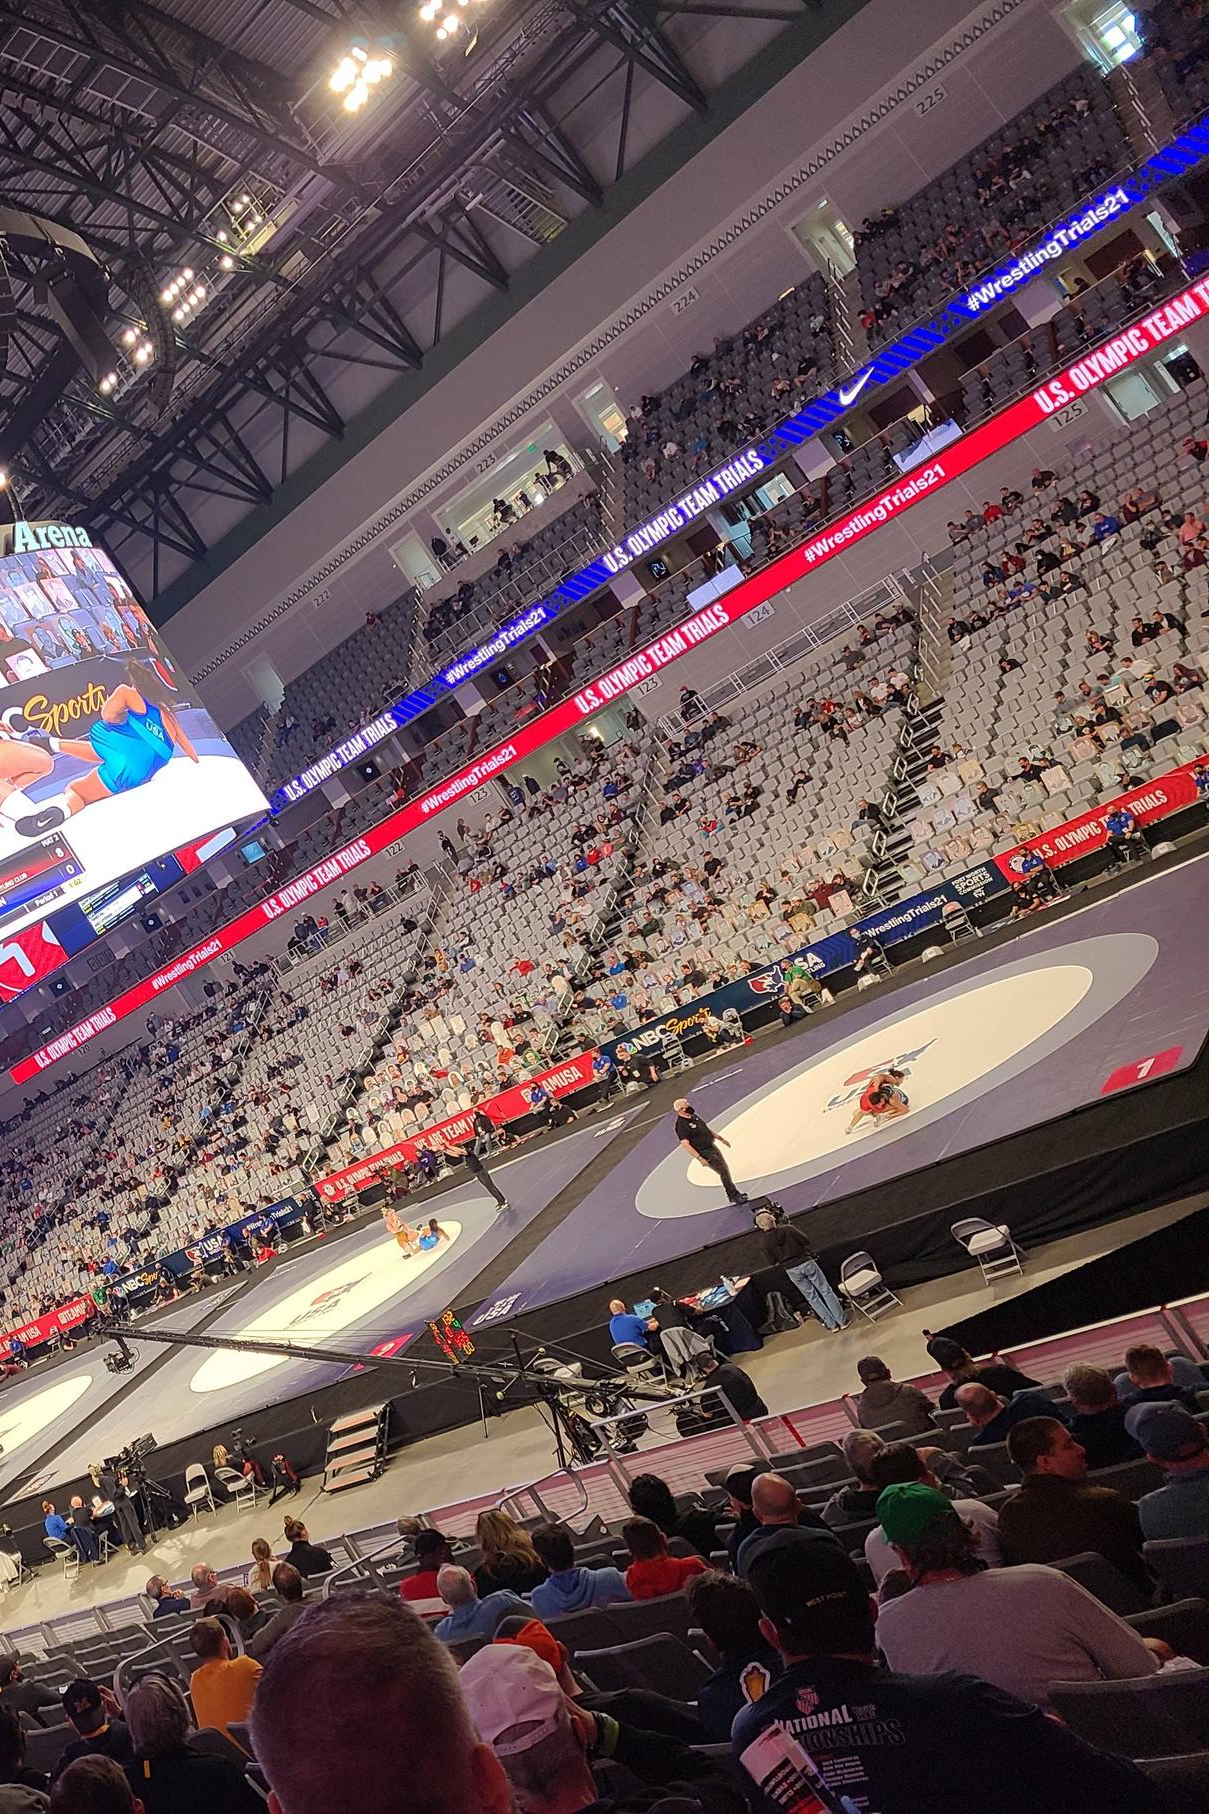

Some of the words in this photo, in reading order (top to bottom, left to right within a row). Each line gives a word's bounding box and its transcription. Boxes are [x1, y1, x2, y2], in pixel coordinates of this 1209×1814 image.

[916, 88, 946, 115] 225
[966, 189, 1131, 312] #WrestlingTrials21
[673, 291, 697, 313] 224
[1034, 380, 1076, 414] U.S.
[1069, 328, 1149, 391] OLYMPIC
[1141, 294, 1202, 341] TEAM
[1052, 403, 1083, 427] 125
[476, 454, 496, 473] 223
[603, 547, 634, 573] U.S.
[627, 508, 684, 555] OLYMPIC
[677, 482, 720, 519] TEAM
[713, 449, 764, 494] TRIALS
[803, 464, 946, 563] #WrestlingTrials21
[11, 522, 93, 555] Arena
[313, 590, 330, 607] 222
[746, 605, 771, 625] 124
[444, 608, 547, 684] #WrestlingTrials21
[574, 691, 604, 714] U.S.
[599, 656, 653, 698] OLYMPIC
[648, 635, 688, 667] TEAM
[681, 604, 730, 644] TRIALS
[637, 678, 659, 696] 123
[283, 779, 307, 801] U.S.
[301, 752, 342, 789] OLYMPIC
[335, 735, 368, 764] TEAM
[361, 712, 398, 747] TRIALS
[421, 746, 517, 814] #WrestlingTrials21
[470, 789, 488, 804] 123
[1127, 790, 1168, 817] TRIALS
[41, 836, 54, 848] MAT
[385, 842, 403, 857] 122
[1055, 822, 1102, 851] OLYMPIC
[14, 872, 28, 883] CLUB
[66, 864, 75, 875] 0
[262, 899, 284, 919] U.S.
[279, 874, 318, 908] OLYMPIC
[313, 860, 343, 885] TEAM
[336, 839, 372, 870] TRIALS
[954, 871, 991, 892] SPORTS
[34, 893, 54, 907] Period
[151, 938, 223, 990] #WrestlingTrials21
[33, 1051, 52, 1068] U.S.
[46, 1032, 77, 1060] OLYMPIC
[73, 1020, 95, 1044] TEAM
[89, 1006, 117, 1032] TRIALS
[633, 1025, 668, 1051] NBC
[1136, 1057, 1156, 1079] 1
[520, 1066, 584, 1104] @AMUSA
[442, 1117, 471, 1138] TEAM
[121, 1276, 145, 1293] NBC
